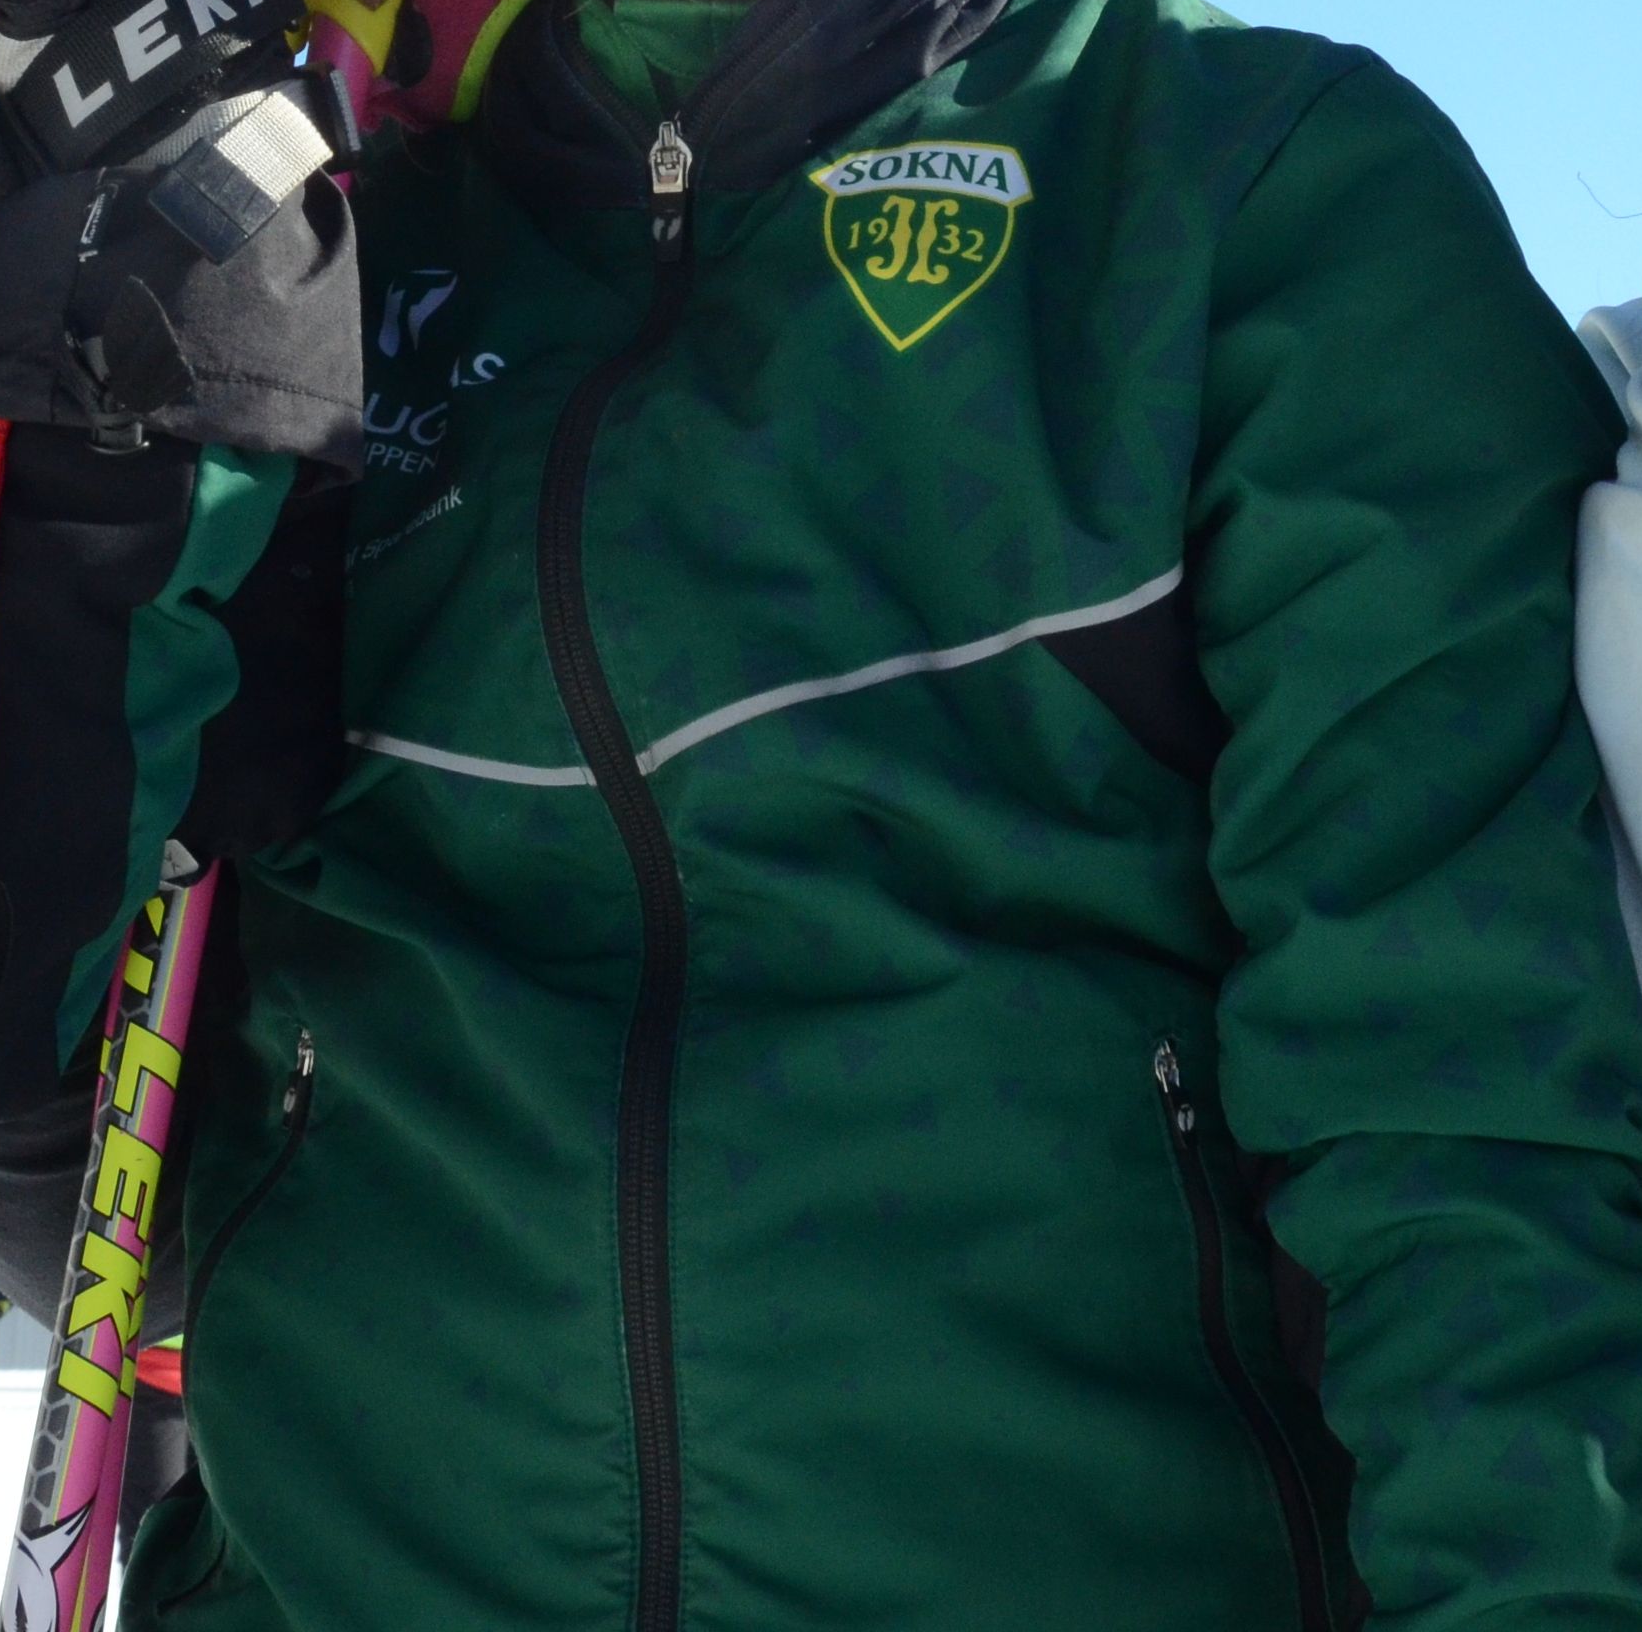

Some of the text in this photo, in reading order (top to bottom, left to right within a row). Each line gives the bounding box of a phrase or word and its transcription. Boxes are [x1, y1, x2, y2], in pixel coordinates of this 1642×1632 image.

[839, 150, 1011, 195] SOKNA
[847, 218, 889, 250] 19
[937, 223, 986, 263] 32
[56, 1018, 184, 1422] LEKI
